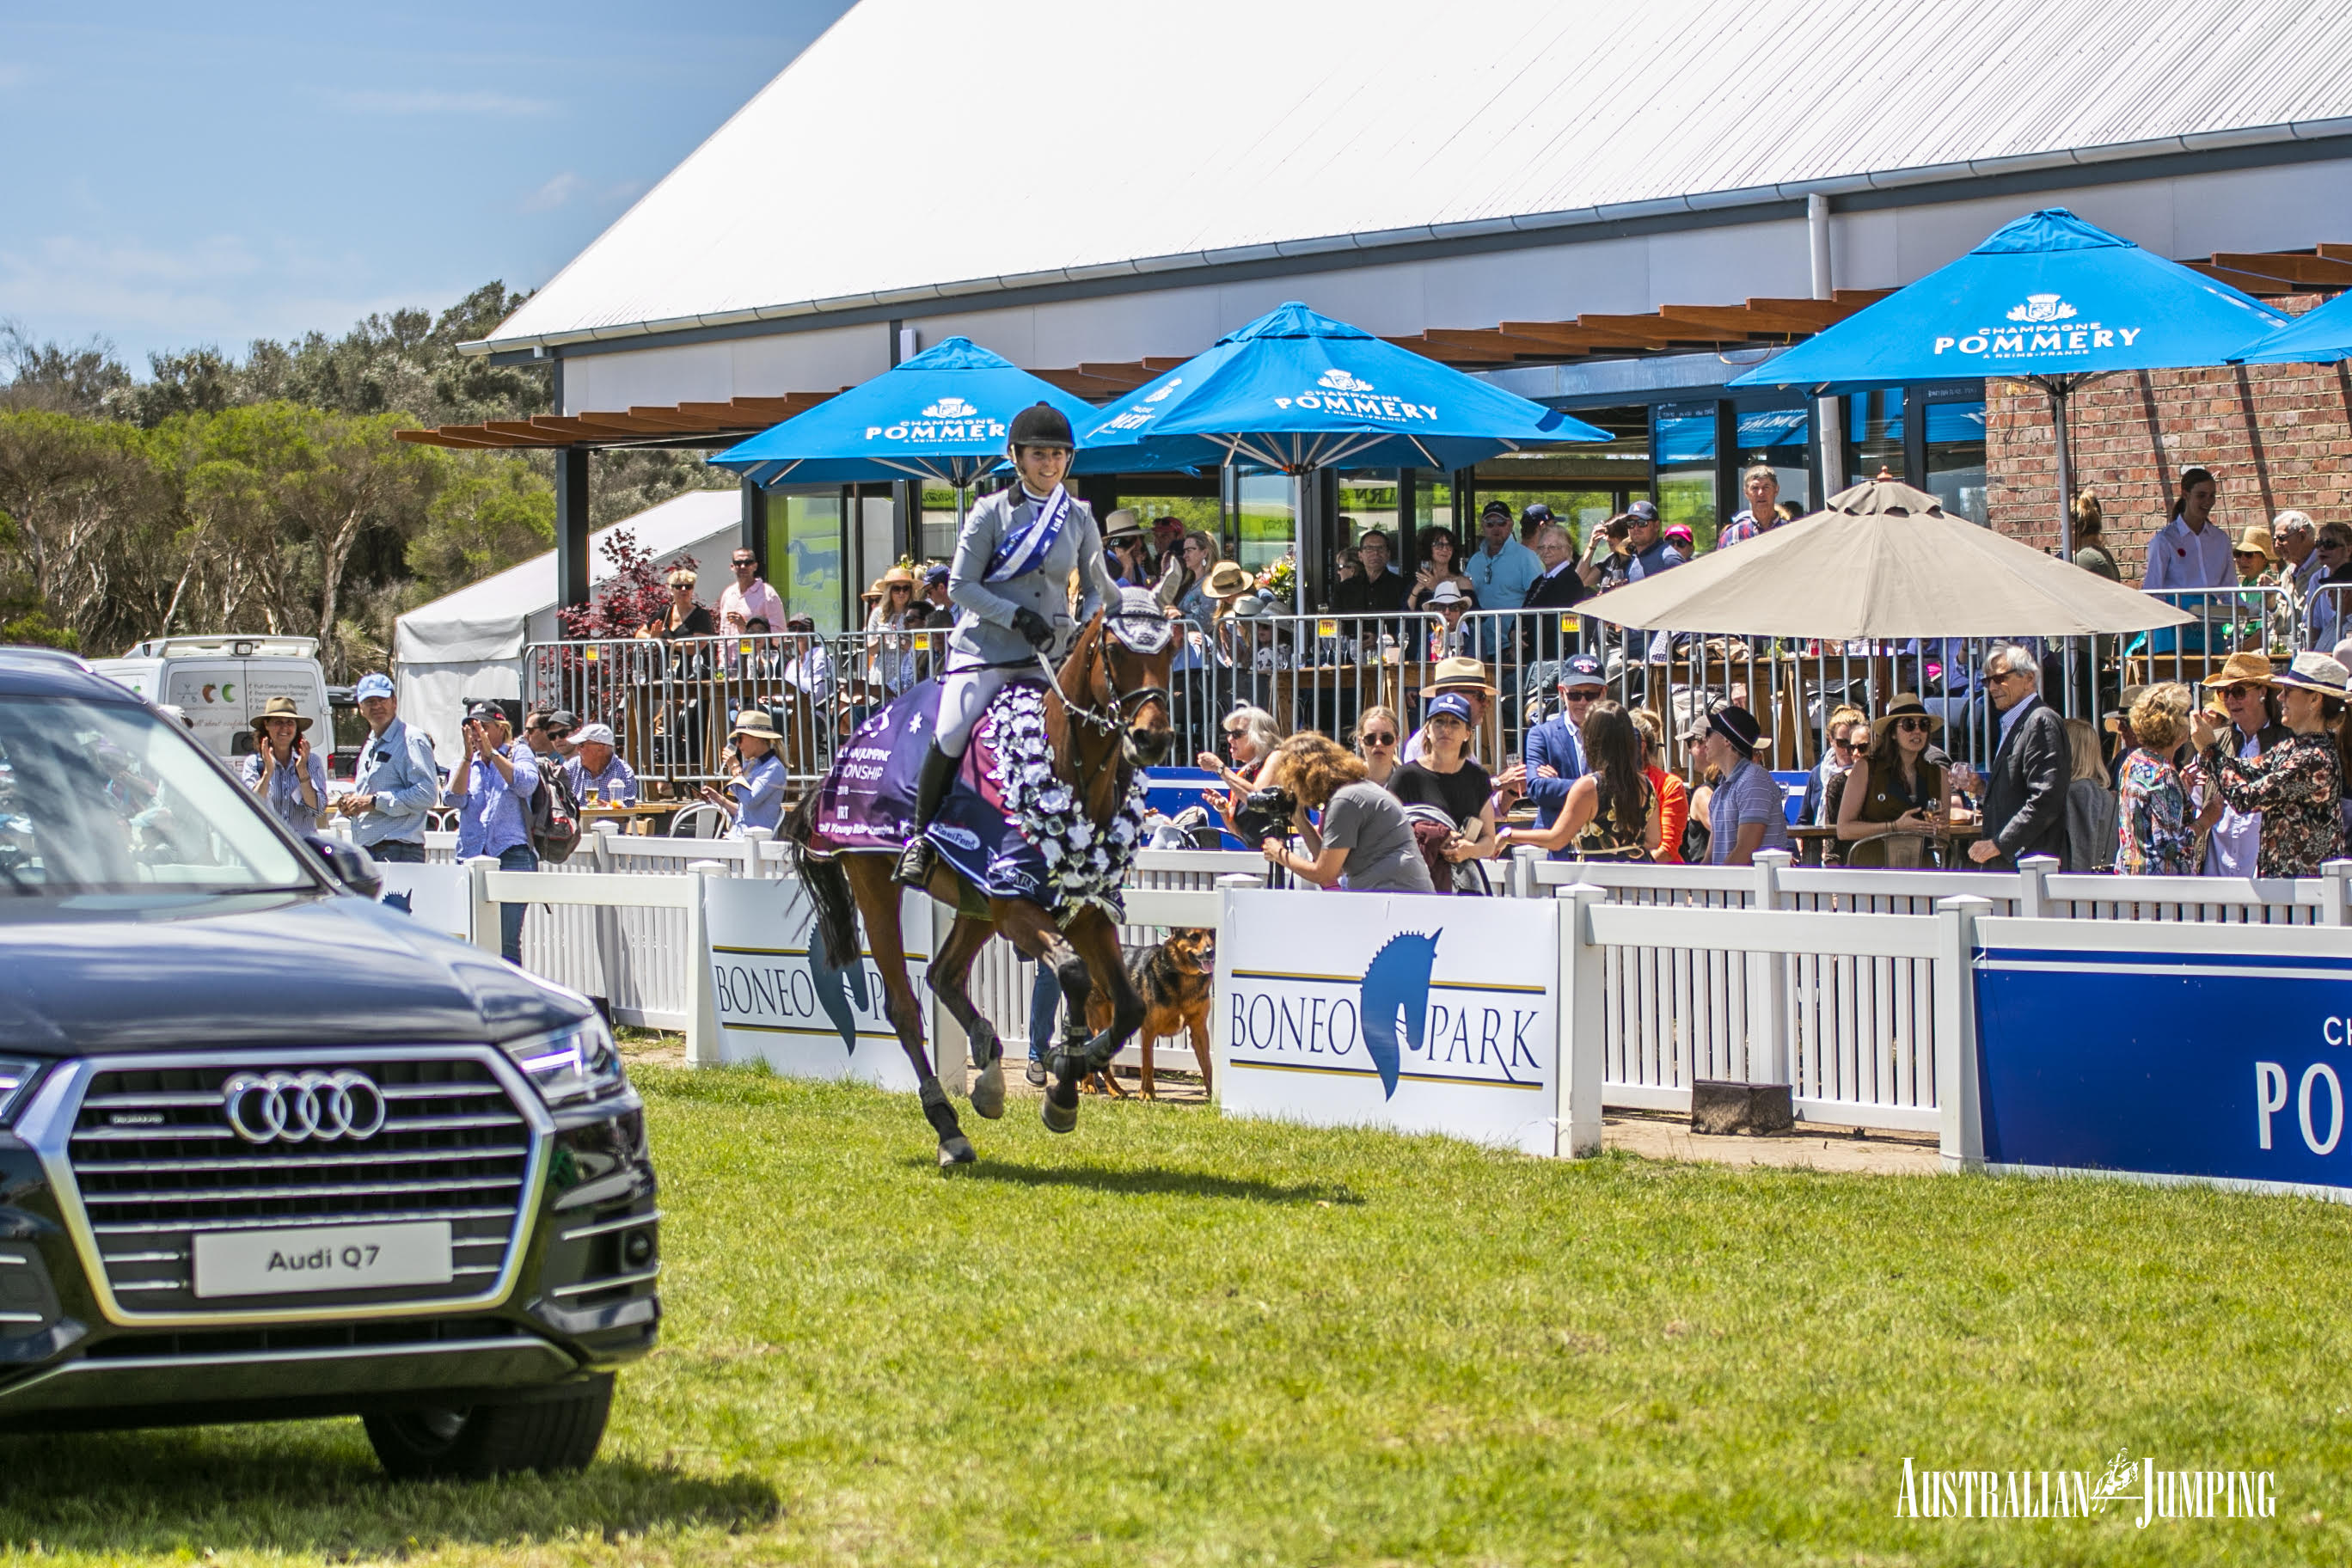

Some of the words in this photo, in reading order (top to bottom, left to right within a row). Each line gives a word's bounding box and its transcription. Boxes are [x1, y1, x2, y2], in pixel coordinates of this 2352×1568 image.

[1979, 322, 2102, 335] CHAMPAGNE
[1934, 328, 2141, 355] POMMERY
[1304, 390, 1402, 403] CHAMPAGNE
[1275, 396, 1438, 420] POMMERY
[866, 423, 1011, 440] POMMER
[900, 419, 995, 427] CHAMPAGNE
[1057, 499, 1070, 519] Pla
[714, 965, 816, 1020] BONEO
[868, 971, 929, 1027] PK
[1230, 993, 1357, 1056] BONEO
[1427, 1004, 1542, 1082] PARK
[266, 1247, 333, 1274] Audi
[341, 1245, 382, 1271] Q7
